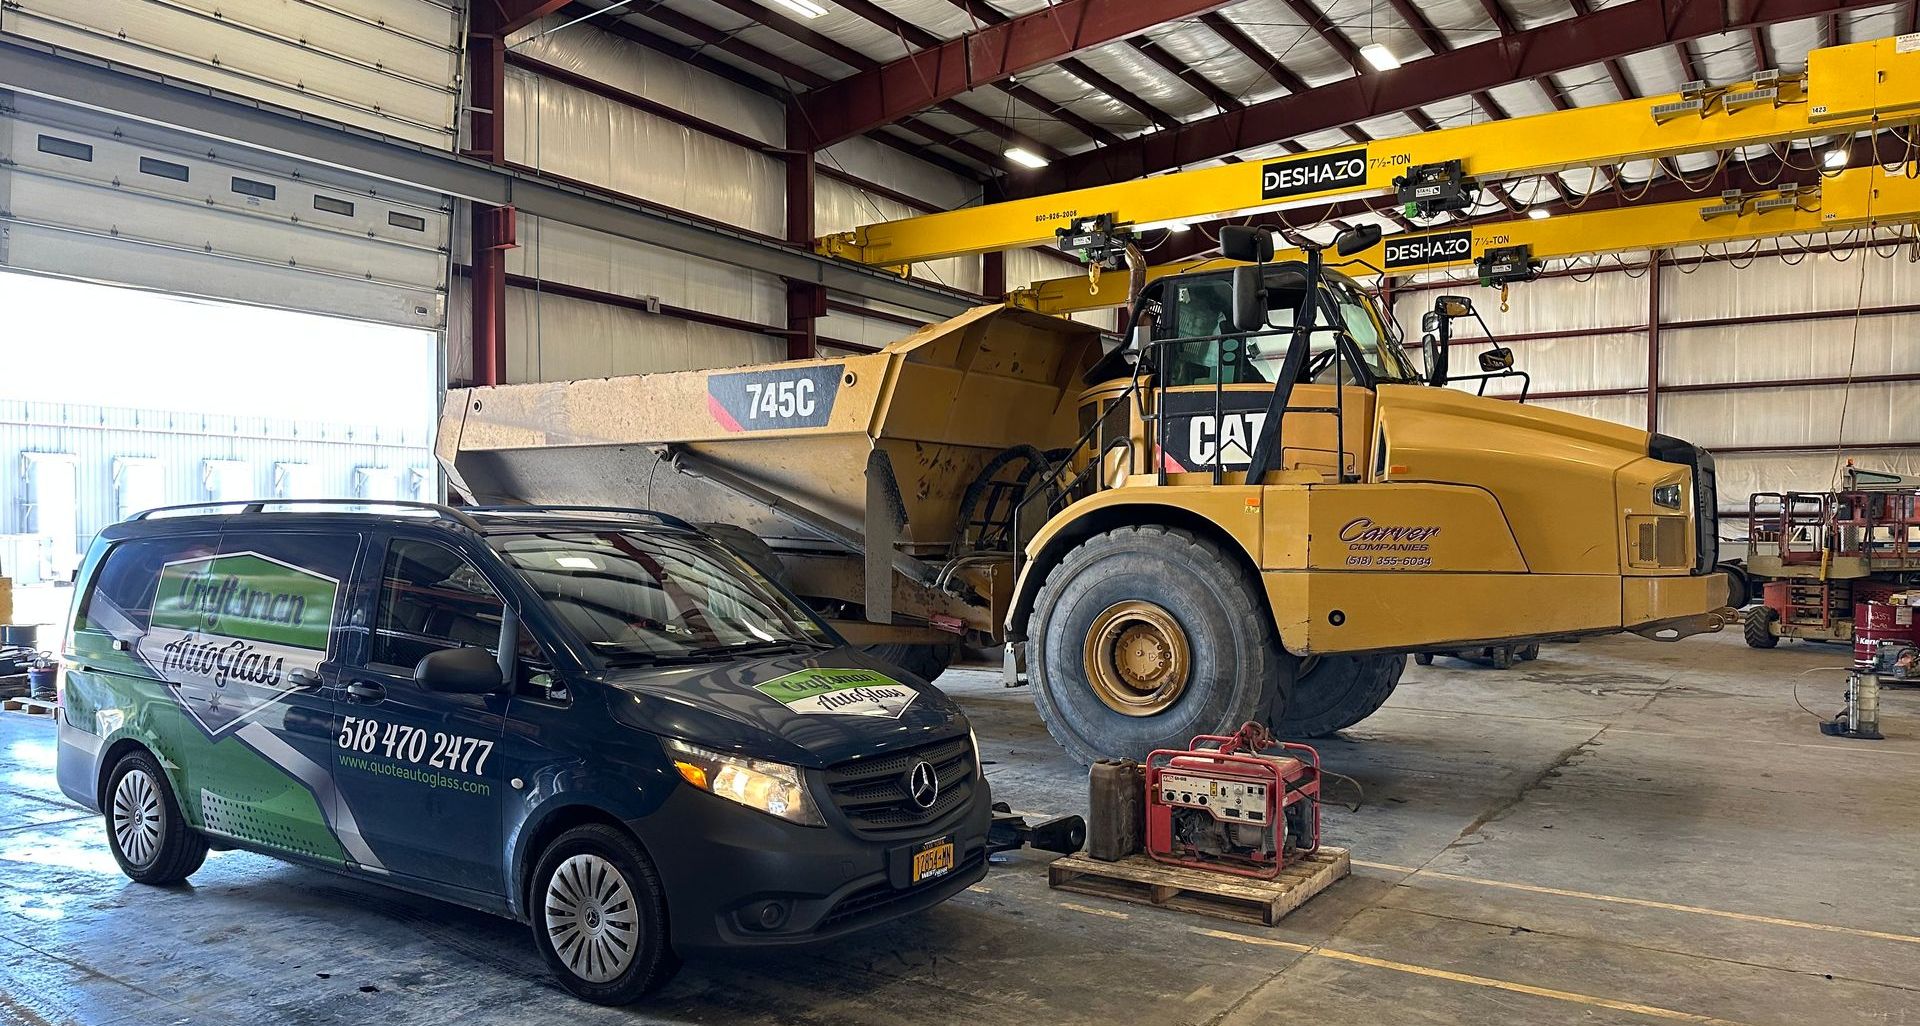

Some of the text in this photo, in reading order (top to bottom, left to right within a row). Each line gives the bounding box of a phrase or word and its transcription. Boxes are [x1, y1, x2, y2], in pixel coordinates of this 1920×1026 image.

[1264, 158, 1364, 191] DESHAZO
[1386, 238, 1470, 261] DESHAZO
[746, 378, 815, 419] 745C
[1190, 412, 1268, 465] CAT
[1339, 517, 1441, 542] Carver
[1345, 555, 1433, 567] (518) 355-6034
[1348, 543, 1430, 552] COMPANIES
[178, 570, 306, 627] Craftsman
[162, 632, 284, 688] AutoGlass
[780, 673, 878, 692] Craftsman
[817, 687, 906, 711] AutoGlass
[338, 715, 494, 776] 518 470 2477
[338, 754, 490, 796] www.quoteautoglass.com
